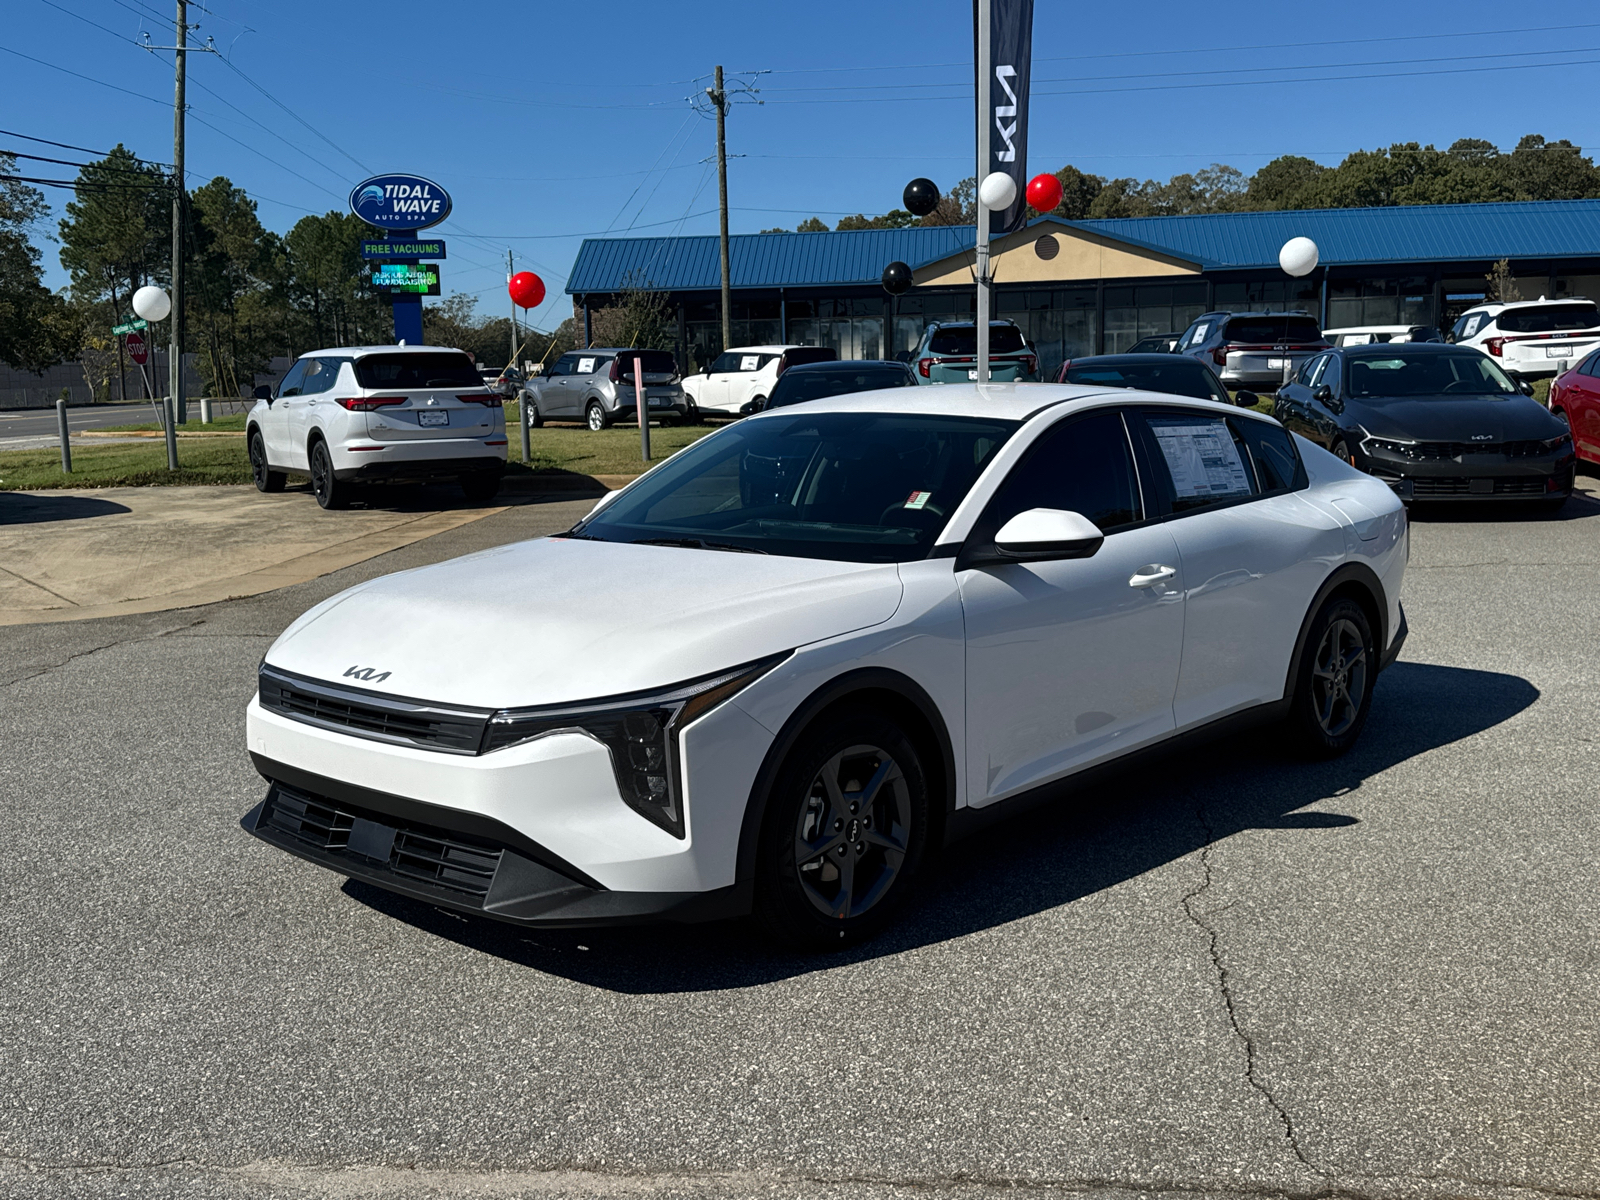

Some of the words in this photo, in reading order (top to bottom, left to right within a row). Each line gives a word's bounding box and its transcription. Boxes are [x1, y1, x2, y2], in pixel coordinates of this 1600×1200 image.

[995, 65, 1017, 162] KIA
[385, 185, 431, 198] TIDAL
[393, 200, 441, 213] WAVE
[365, 244, 391, 254] FREE
[393, 244, 440, 254] VACUUMS
[128, 343, 145, 355] STOP
[342, 665, 392, 683] KIA
